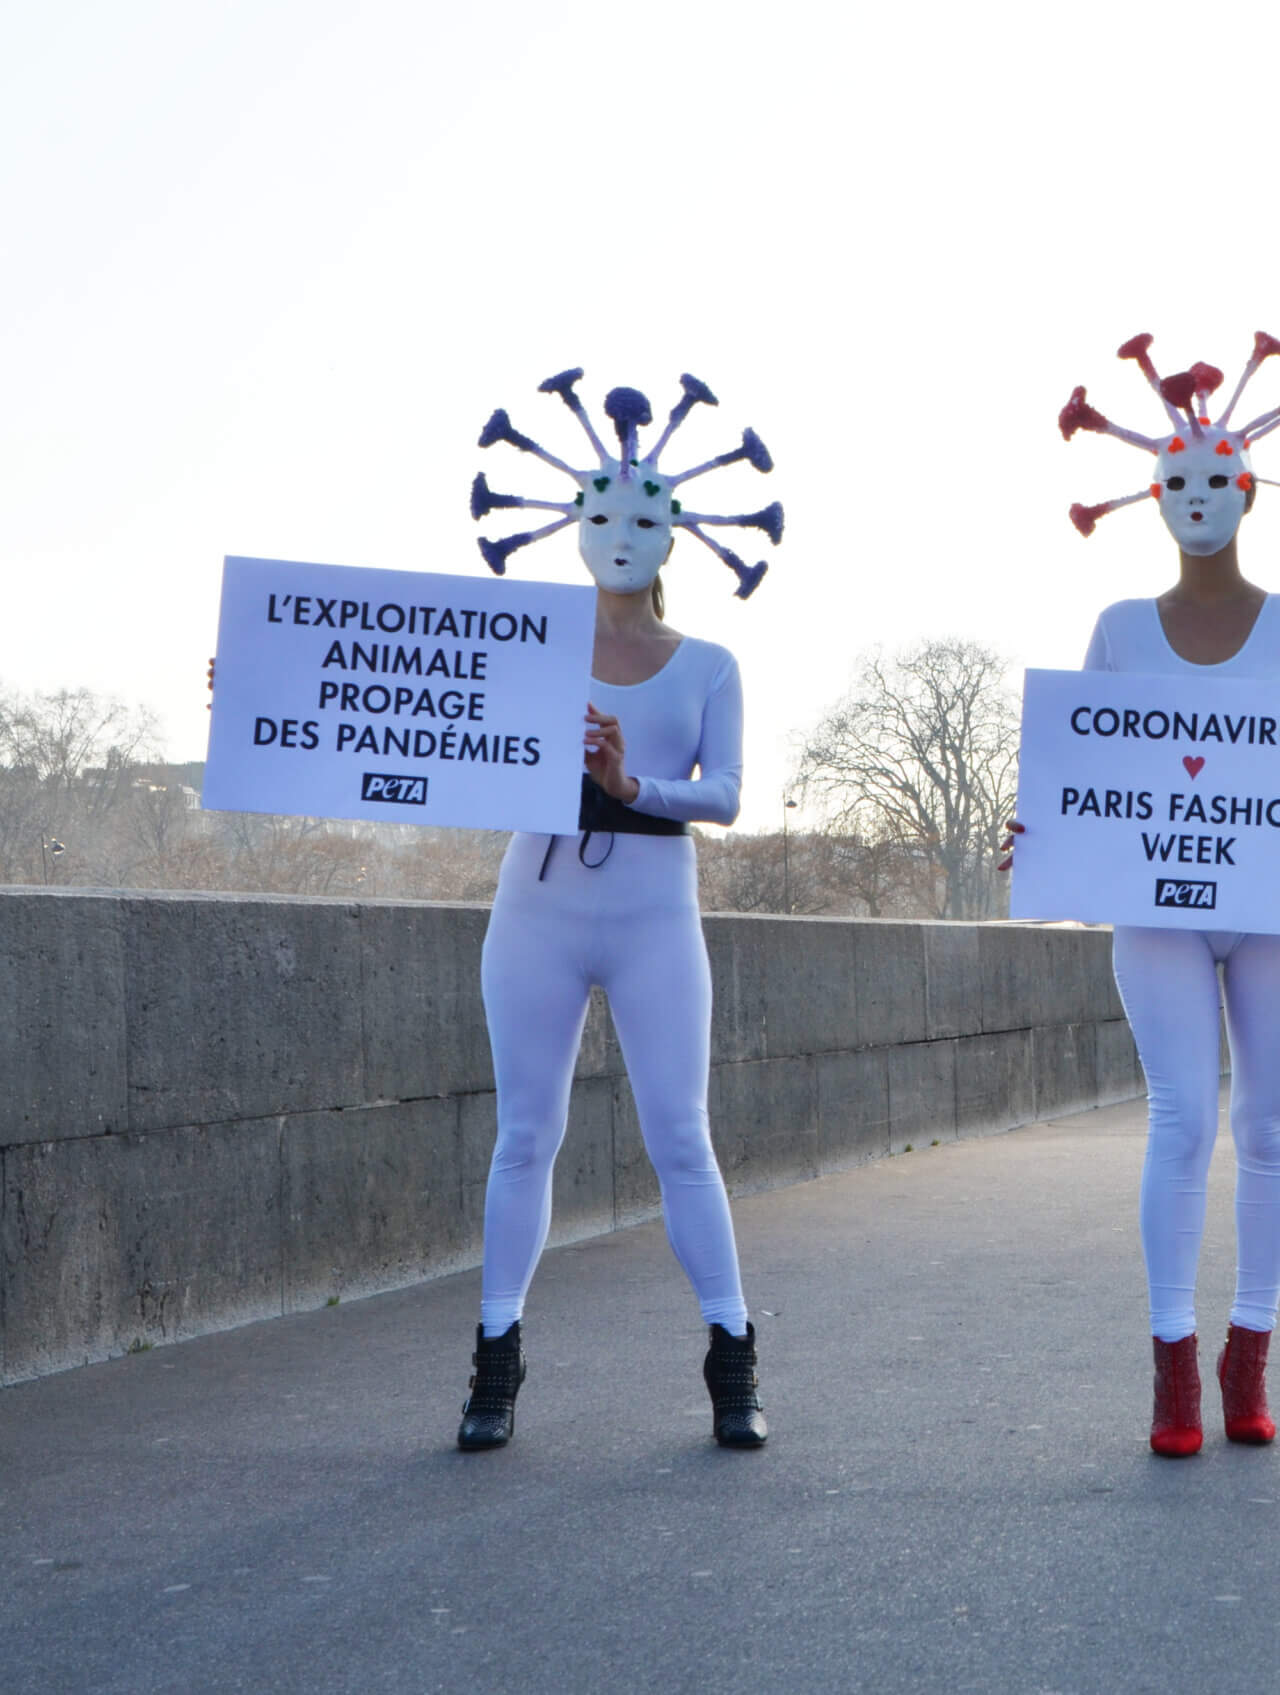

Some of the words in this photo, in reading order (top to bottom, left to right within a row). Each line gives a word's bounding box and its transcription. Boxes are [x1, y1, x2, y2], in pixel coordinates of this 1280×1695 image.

[322, 640, 487, 681] ANIMALE
[319, 681, 485, 721] PROPAGE
[254, 717, 319, 751] DES
[337, 725, 541, 766] PANDÉMIES
[1061, 787, 1153, 820] PARIS
[1141, 833, 1236, 865] WEEK
